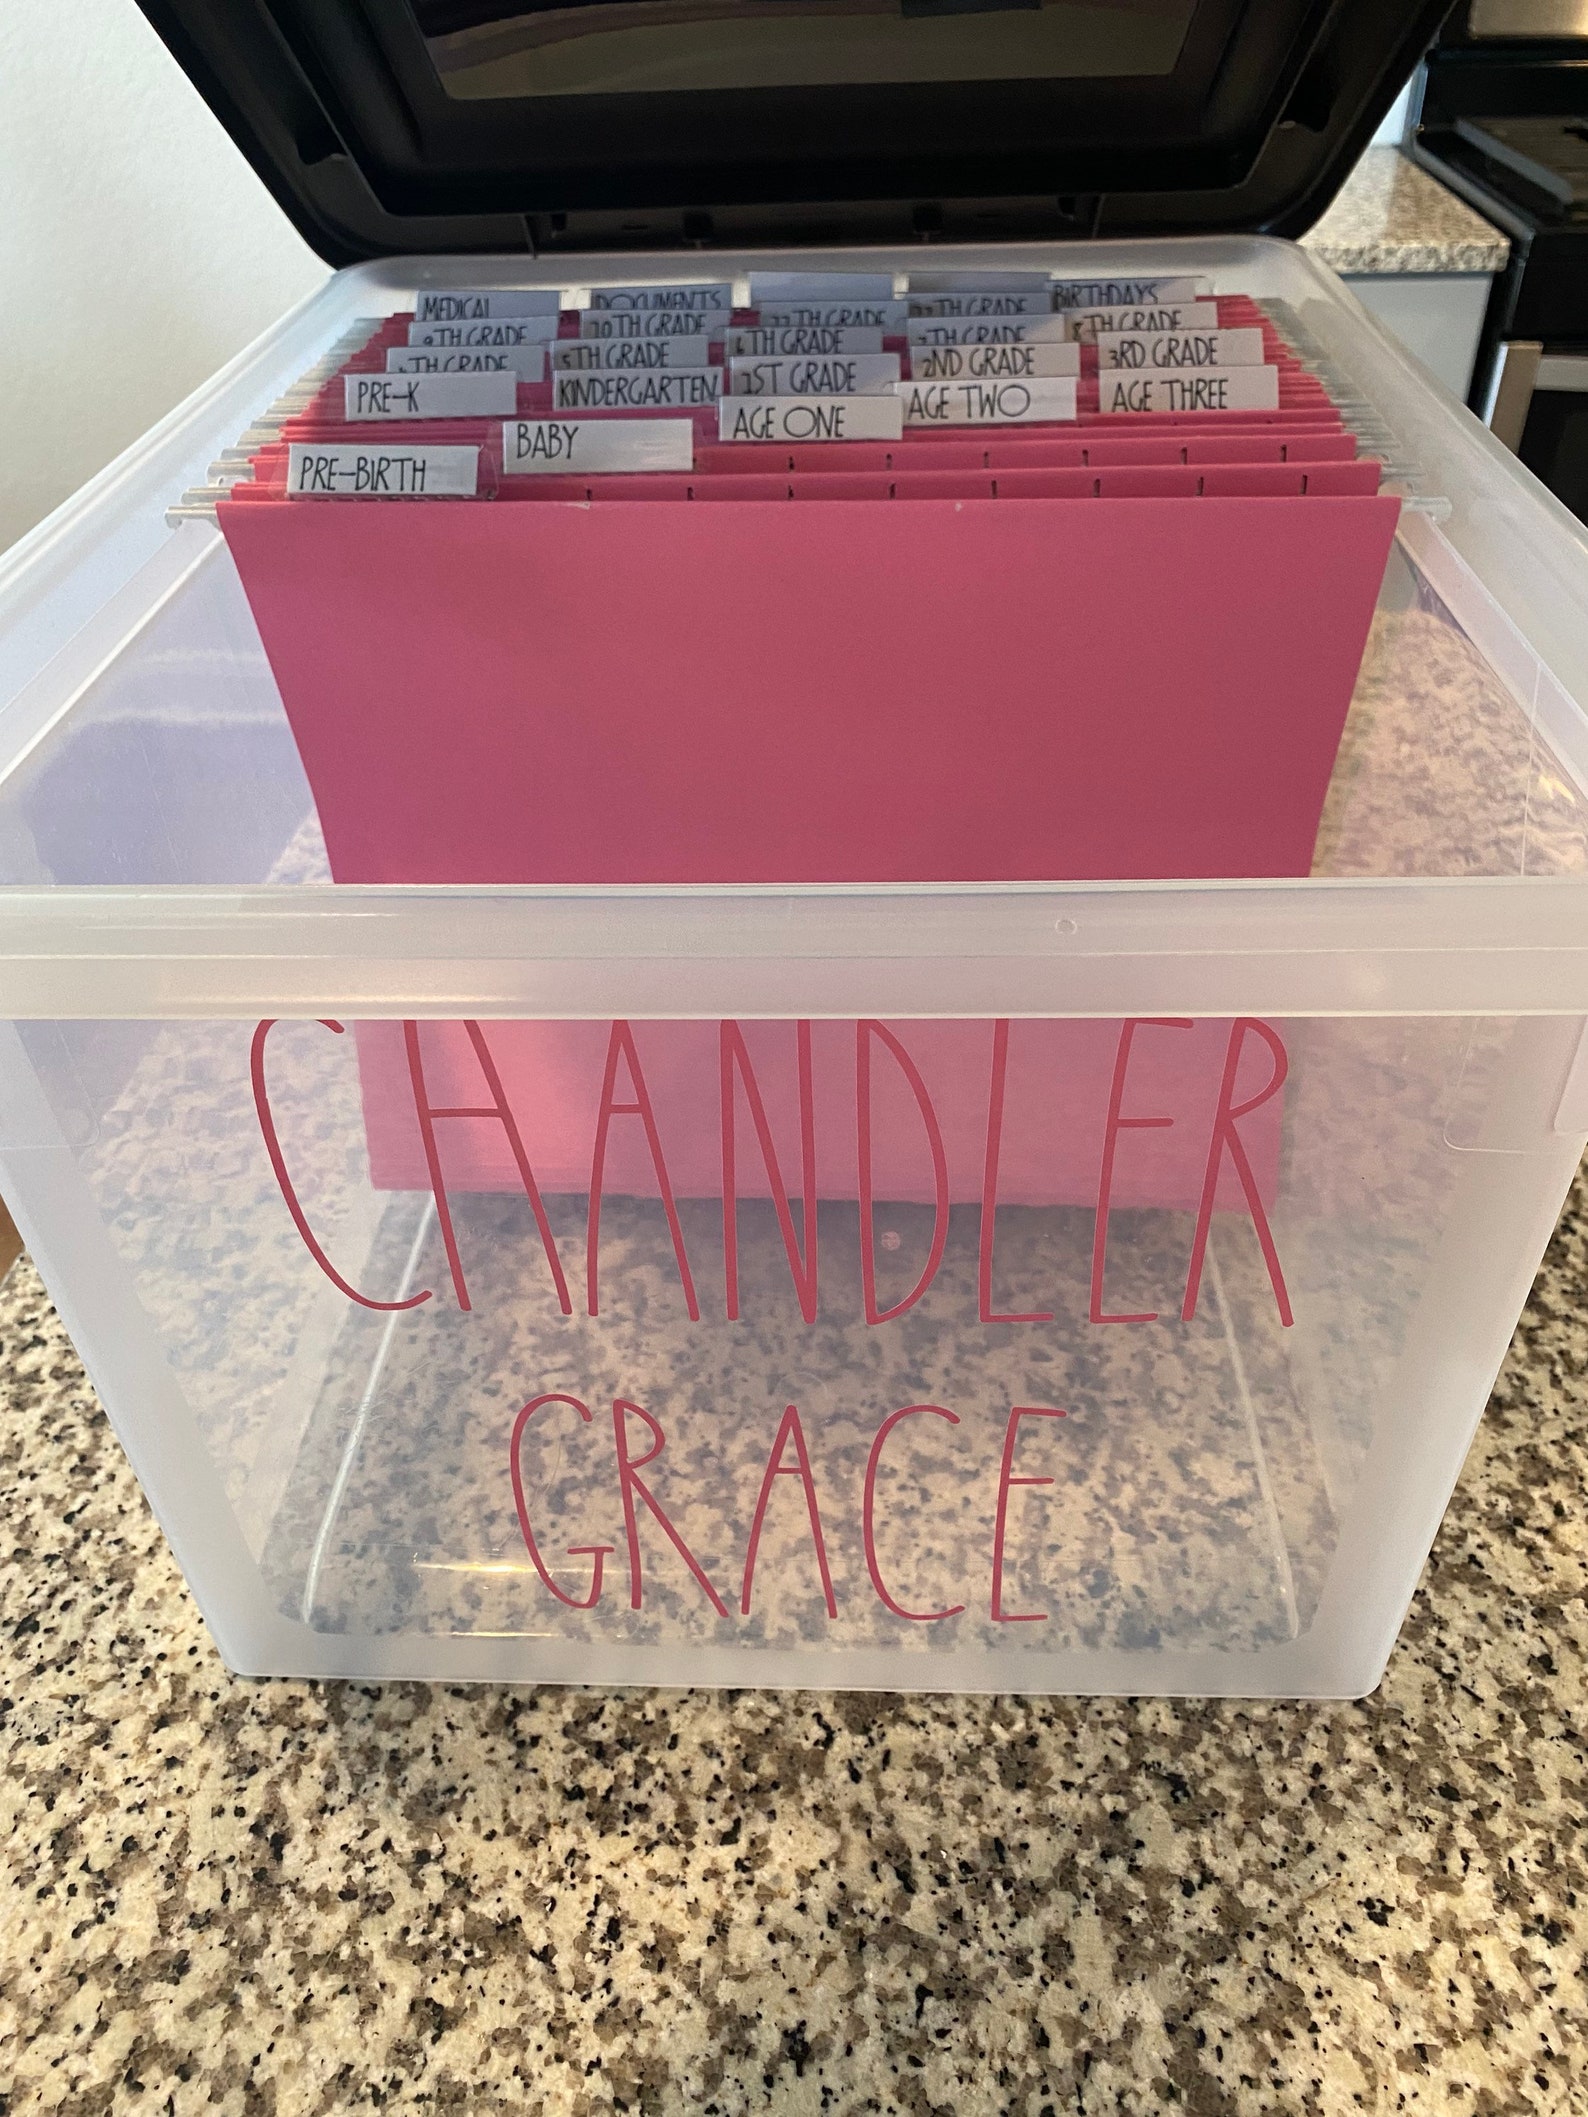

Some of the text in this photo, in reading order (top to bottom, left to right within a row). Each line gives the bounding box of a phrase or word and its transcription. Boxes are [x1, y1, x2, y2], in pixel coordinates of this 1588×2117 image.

[422, 296, 490, 320] MEDICAL
[593, 288, 722, 310] DOCUMENTS
[966, 296, 1027, 315] GRADE
[1050, 283, 1159, 312] BIRTHDAYS
[589, 313, 707, 338] 10TH GRADE
[826, 308, 887, 326] GRADE
[1119, 310, 1181, 331] GRADE
[465, 325, 527, 346] GRADE
[780, 329, 845, 354] GRADE
[961, 325, 1026, 344] GRADE
[444, 354, 508, 373] GRADE
[561, 341, 670, 369] 5TH GRADE
[923, 347, 1036, 378] 2ND GRADE
[1110, 337, 1219, 369] 3RD GRADE
[559, 374, 718, 408] KINDERGARTEN
[741, 360, 857, 395] 1ST GRADE
[357, 381, 419, 413] PRE-K
[908, 383, 1031, 419] AGE TWO
[1112, 378, 1229, 413] AGE THREE
[733, 405, 846, 438] AGE ONE
[517, 423, 579, 459] BABY
[300, 456, 426, 492] PRE-BIRTH
[250, 1017, 1294, 1328] CHANDLER
[510, 1393, 1067, 1622] GRACE
